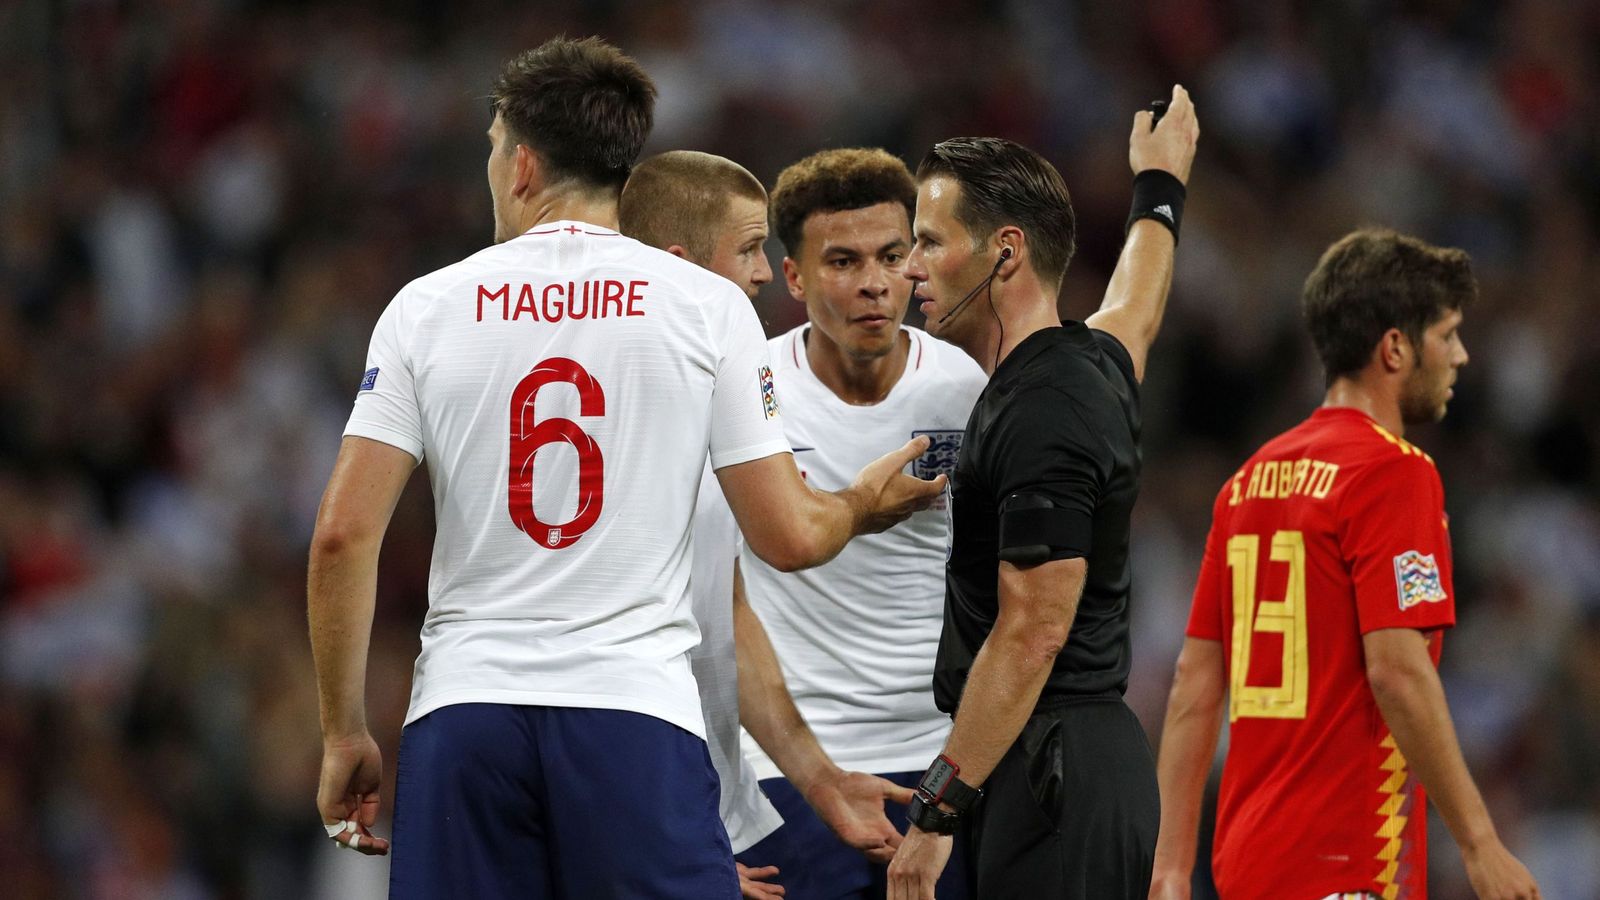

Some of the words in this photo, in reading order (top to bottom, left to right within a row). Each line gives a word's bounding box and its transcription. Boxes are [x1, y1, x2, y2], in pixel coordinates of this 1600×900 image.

[476, 280, 649, 323] MAGUIRE
[508, 357, 605, 549] 6
[1245, 458, 1340, 499] ROBRTO
[1227, 530, 1309, 723] 13
[928, 763, 948, 788] GOAL
